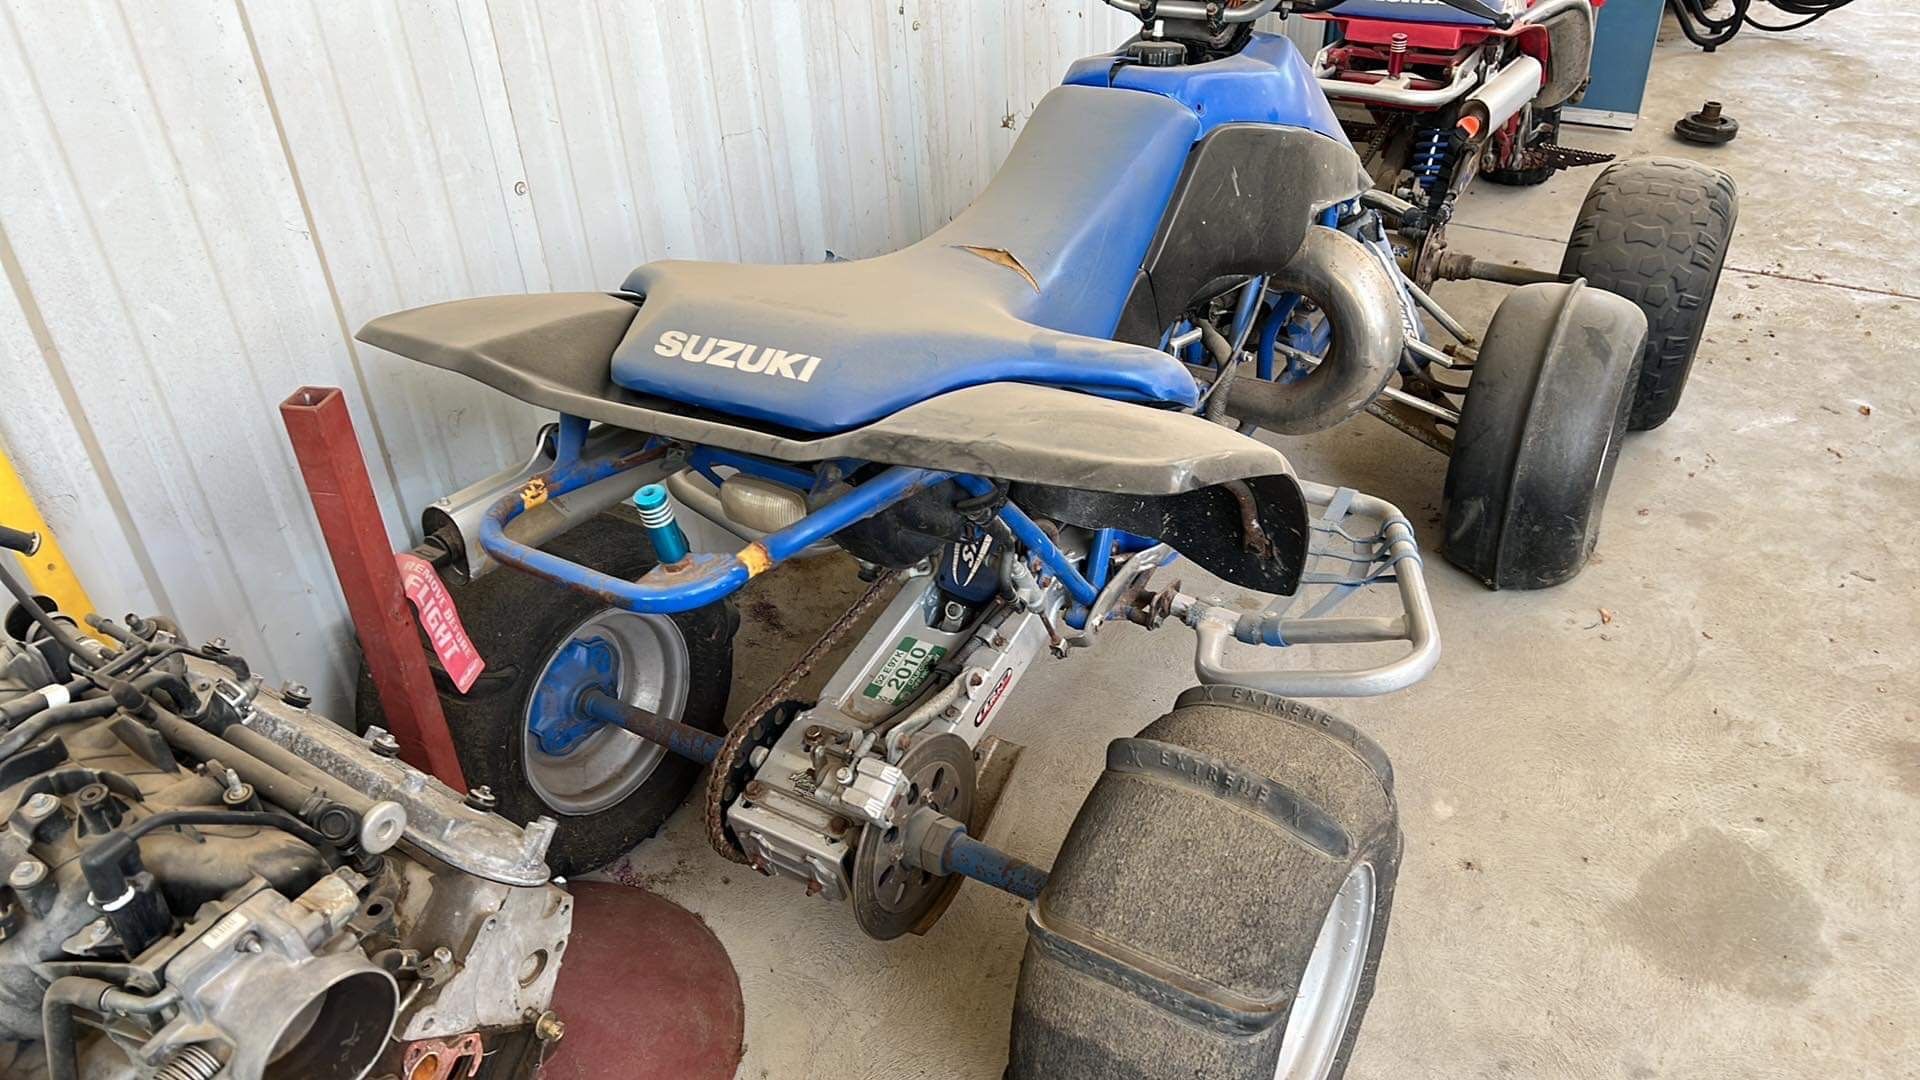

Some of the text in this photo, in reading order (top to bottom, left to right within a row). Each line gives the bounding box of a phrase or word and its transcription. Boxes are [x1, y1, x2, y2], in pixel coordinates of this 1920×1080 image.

[653, 330, 822, 382] SUZUKI
[404, 561, 446, 607] REMOVE
[443, 607, 473, 660] BEFORE
[404, 574, 461, 660] FLIGHT
[887, 647, 926, 691] 2010
